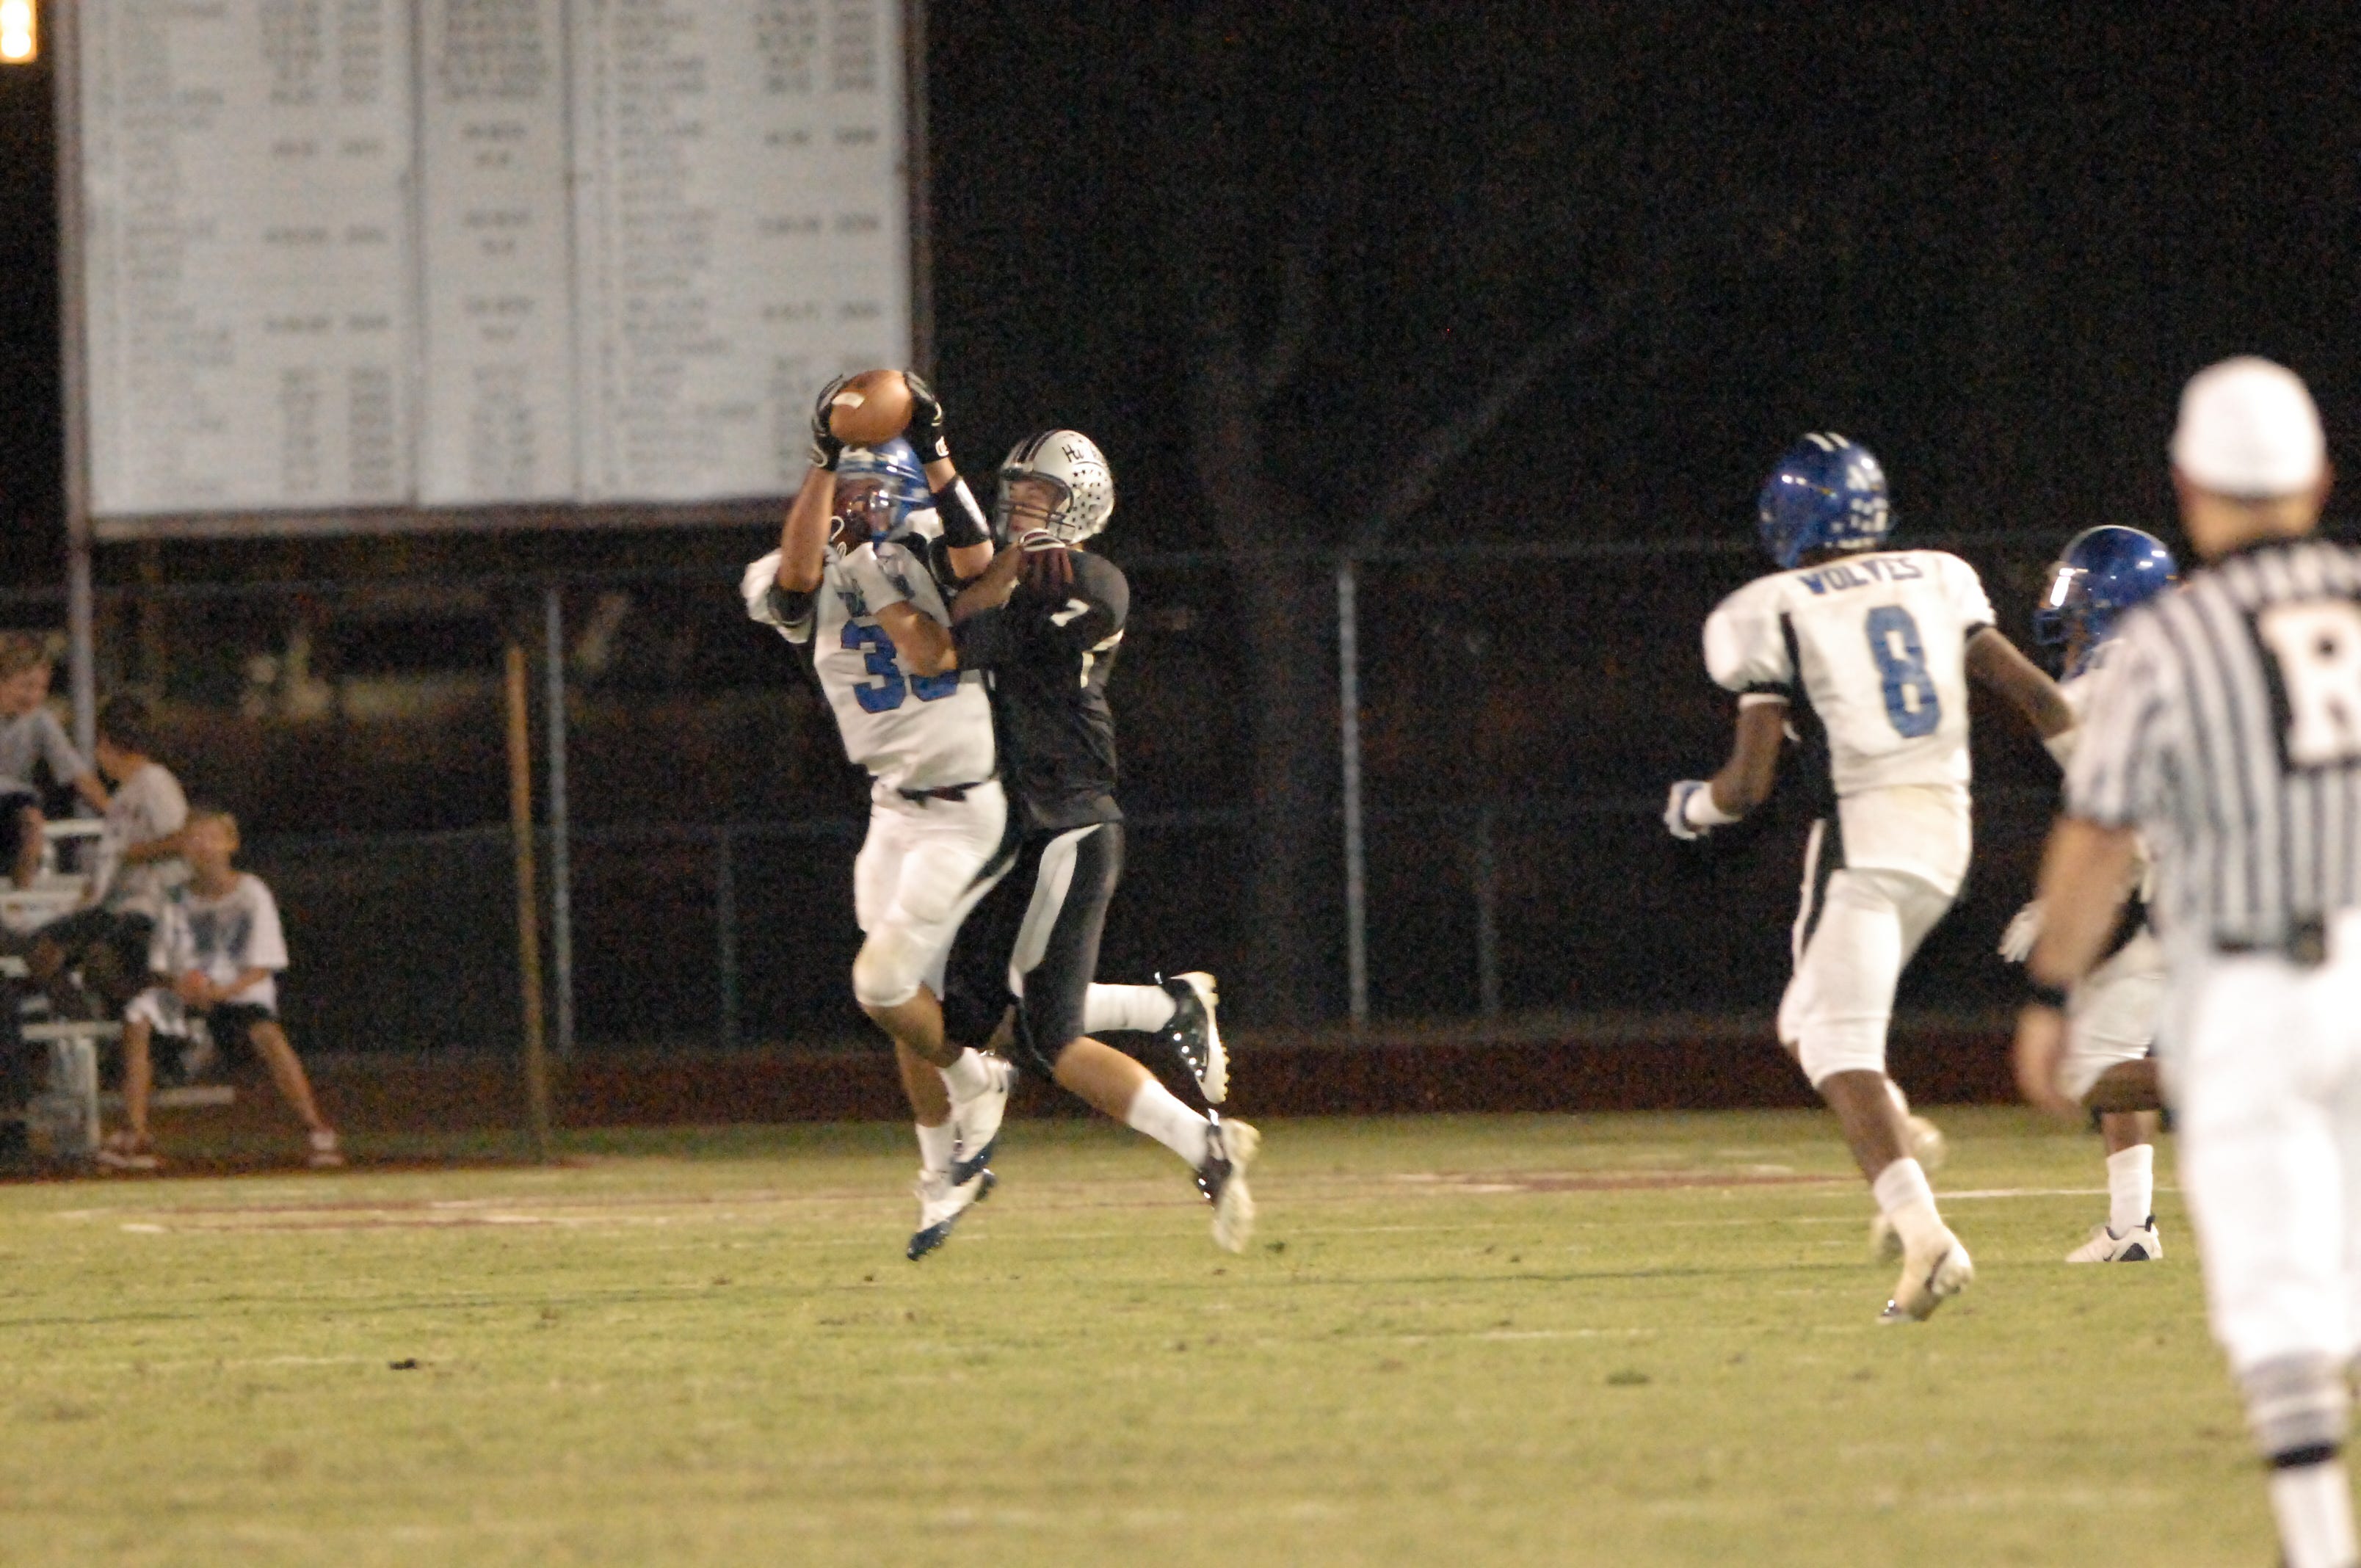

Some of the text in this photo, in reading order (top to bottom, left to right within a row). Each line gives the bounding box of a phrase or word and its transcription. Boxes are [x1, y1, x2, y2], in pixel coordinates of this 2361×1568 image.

[1798, 557, 1923, 595] WOLVES
[1865, 605, 1942, 738] 8
[2258, 600, 2361, 763] R
